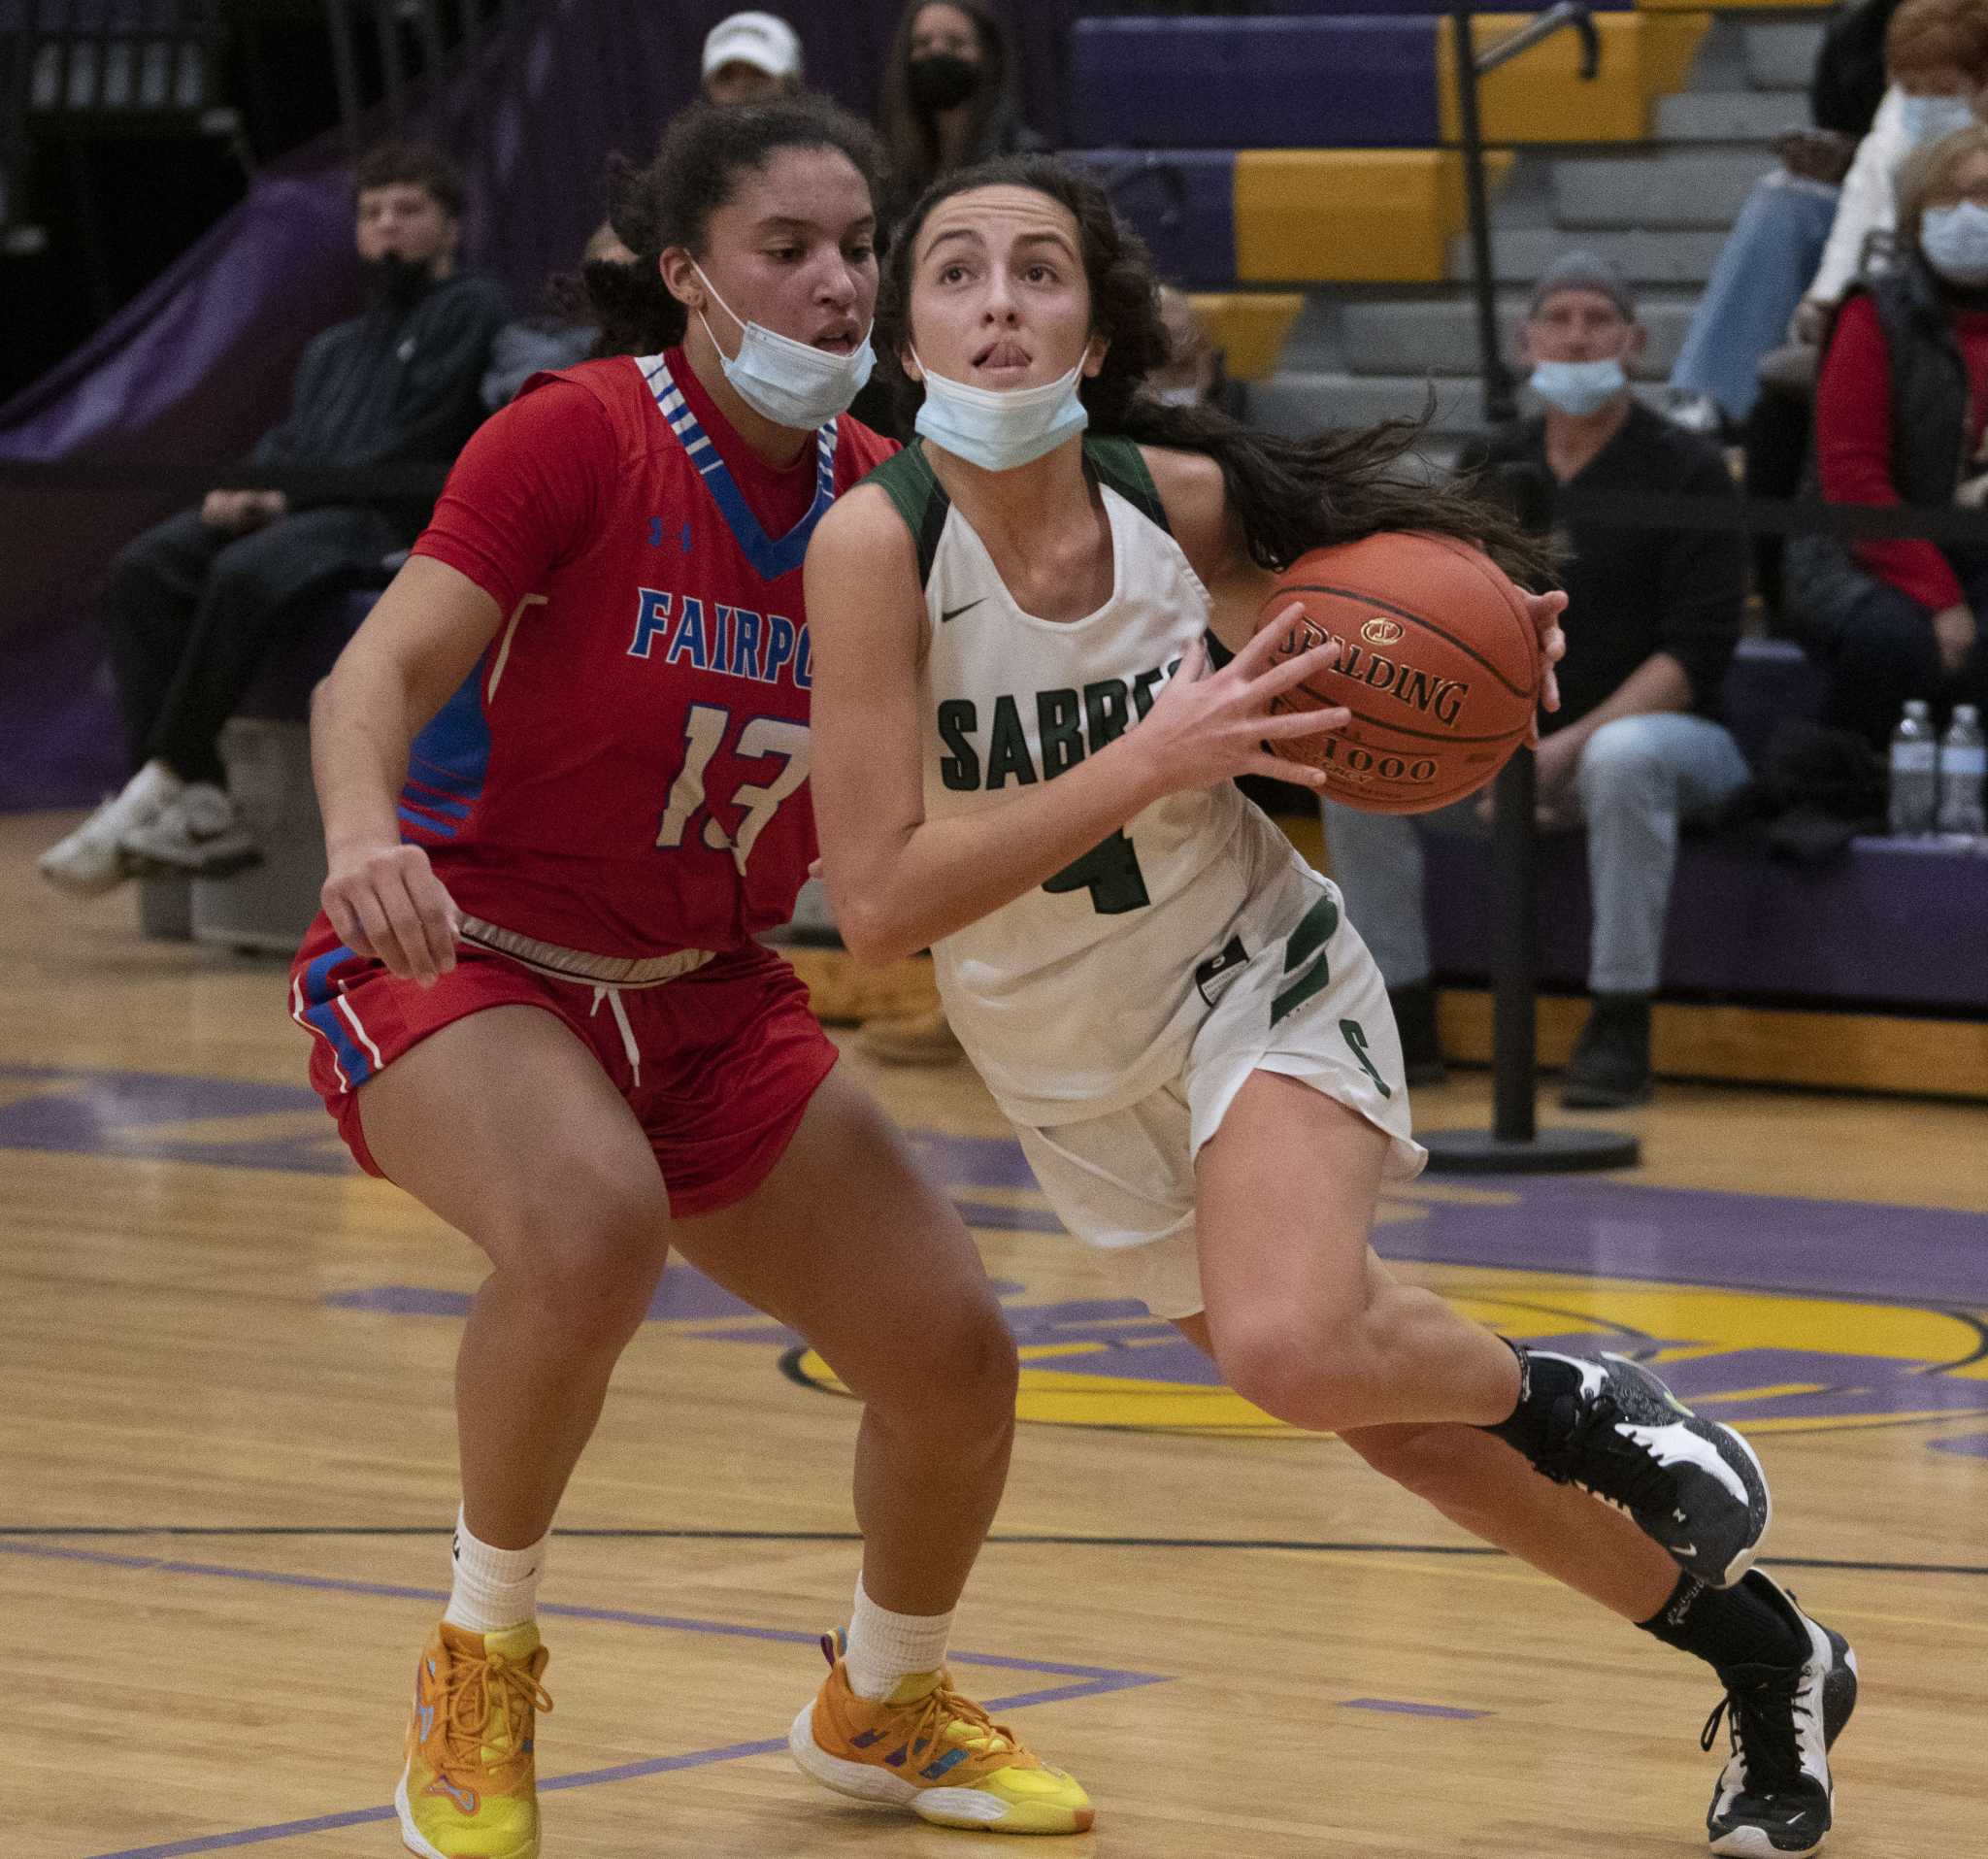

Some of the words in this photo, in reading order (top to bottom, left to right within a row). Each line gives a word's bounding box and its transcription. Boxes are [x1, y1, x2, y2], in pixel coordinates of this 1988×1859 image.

[655, 701, 812, 878] 13
[937, 658, 1183, 791] SABR
[1324, 735, 1438, 780] 1000
